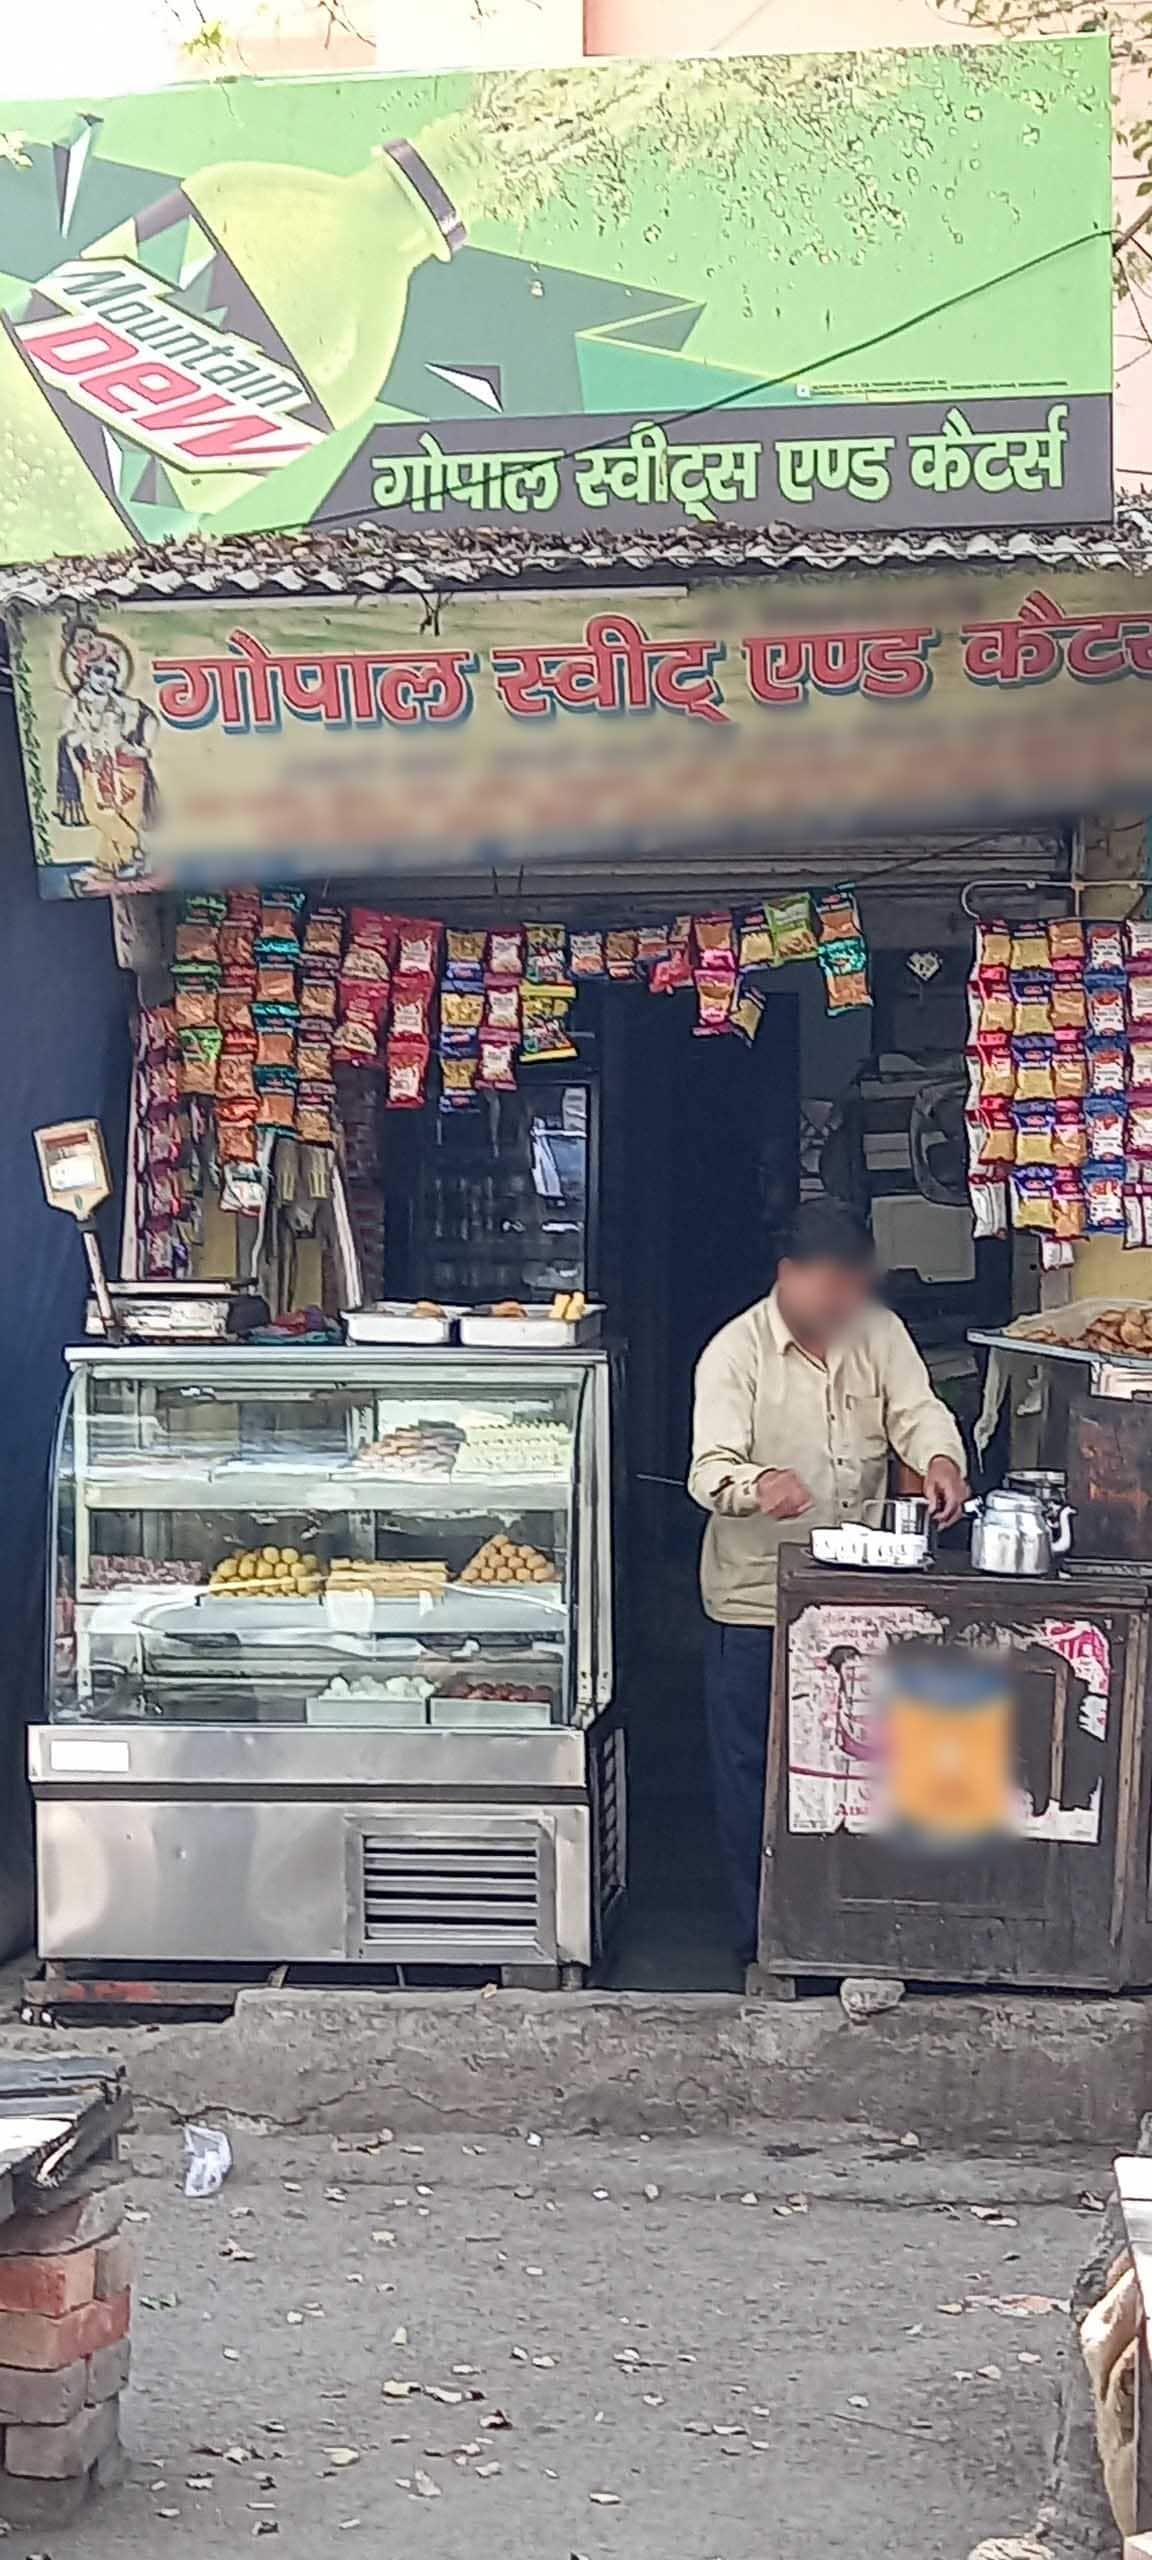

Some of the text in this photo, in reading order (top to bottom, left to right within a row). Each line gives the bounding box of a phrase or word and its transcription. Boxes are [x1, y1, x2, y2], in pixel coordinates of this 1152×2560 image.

[57, 270, 304, 408] Mountain
[371, 403, 1070, 523] गोपाल स्वीट्स एण्ड कैटर्स
[152, 629, 478, 732] गोपाल
[491, 611, 729, 726] स्वीट्
[741, 626, 938, 705] एण्ड
